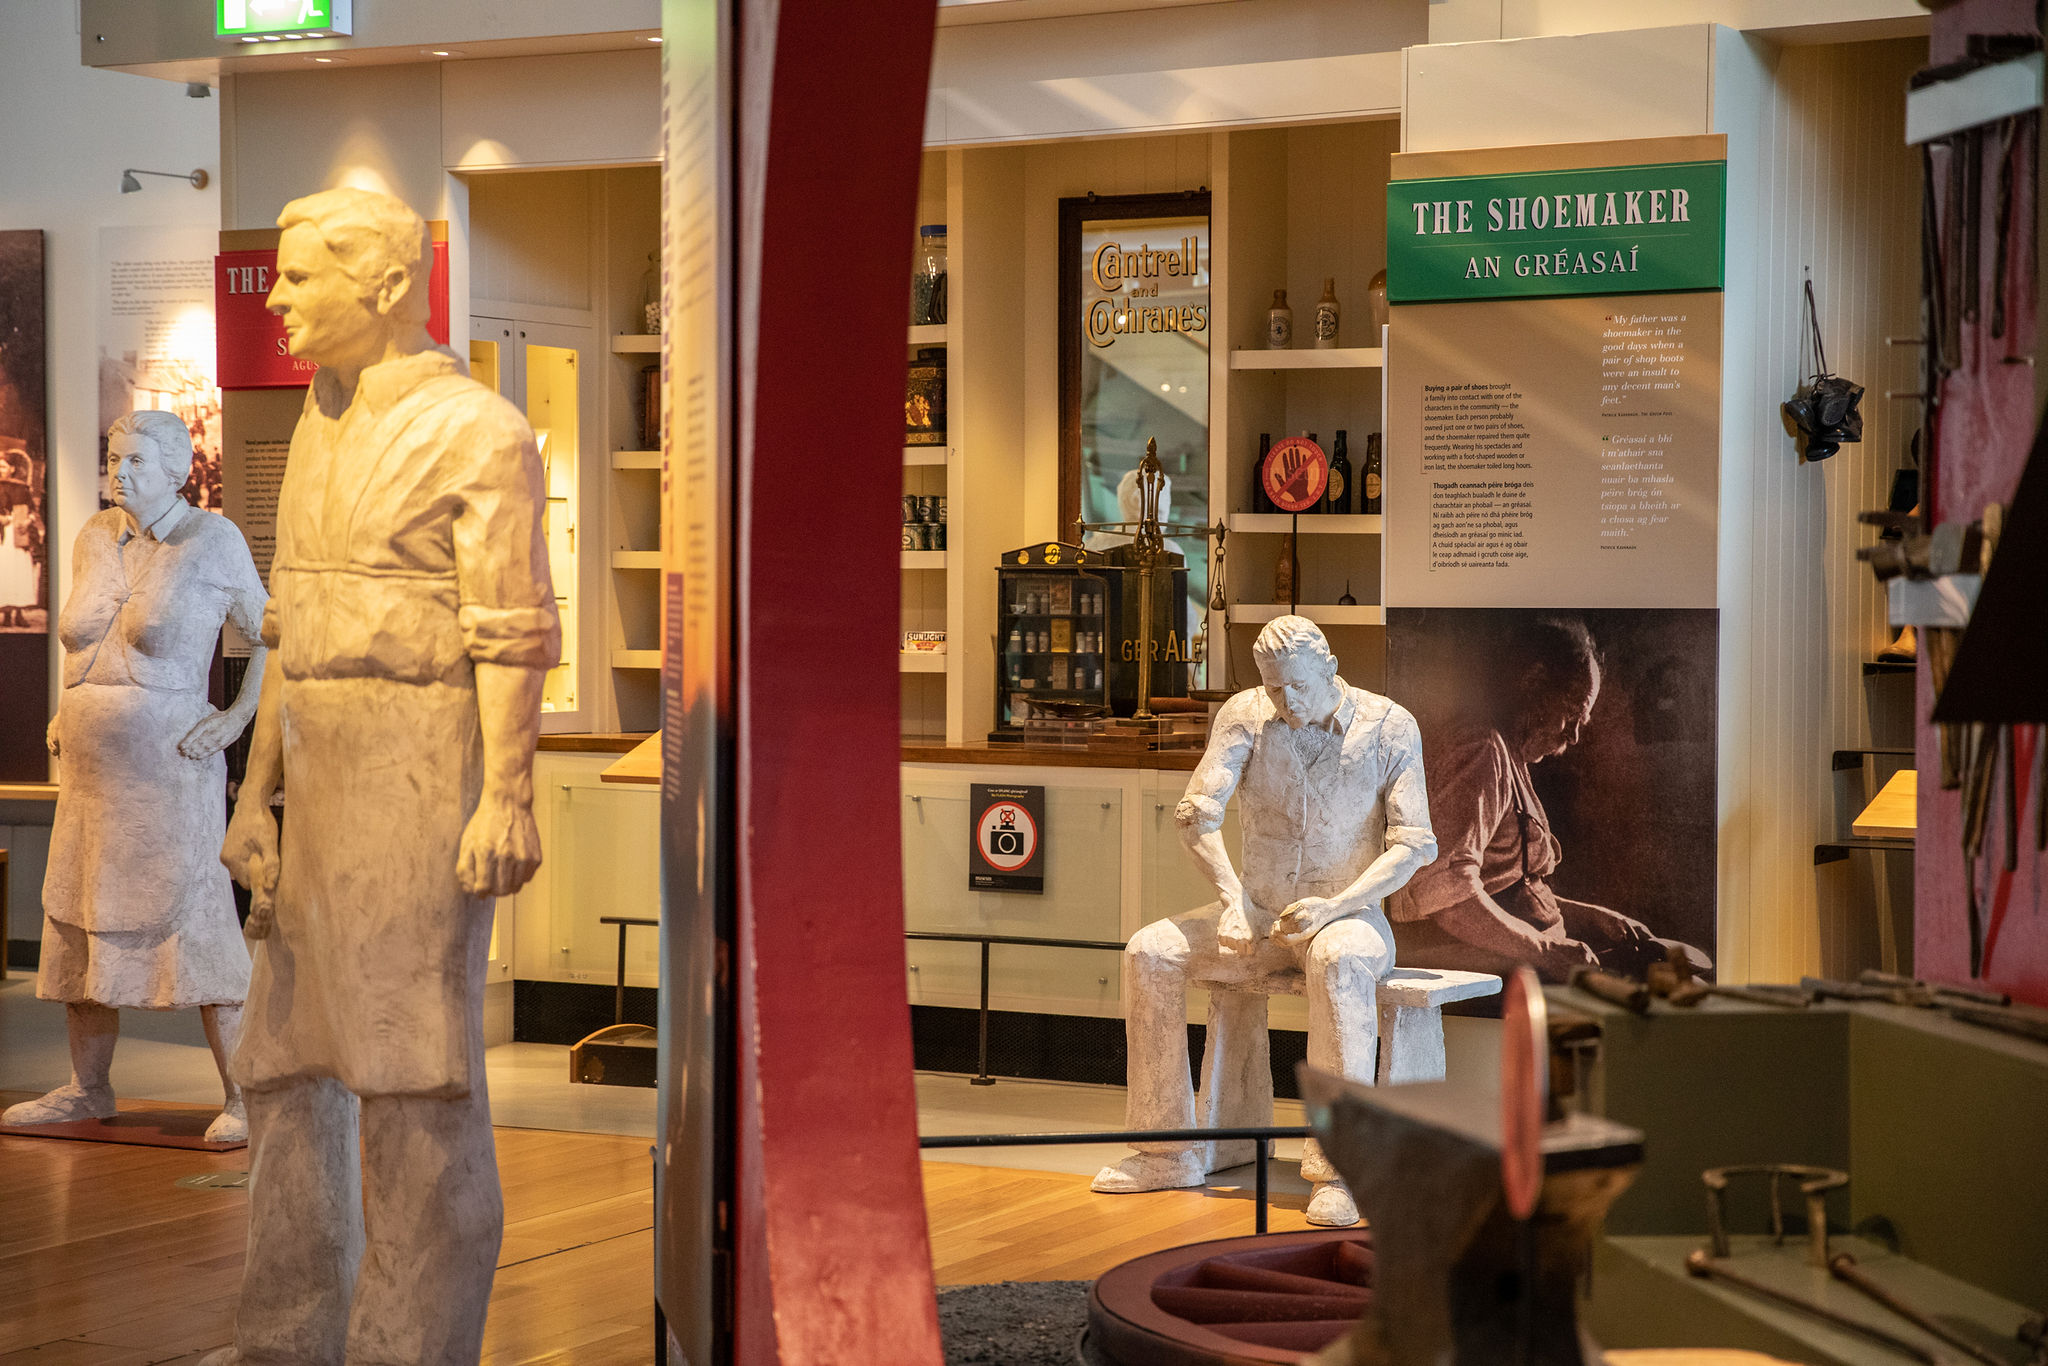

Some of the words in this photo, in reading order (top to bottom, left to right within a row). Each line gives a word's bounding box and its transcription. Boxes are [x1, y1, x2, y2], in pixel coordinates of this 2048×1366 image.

[1412, 199, 1473, 235] THE
[1487, 188, 1691, 232] SHOEMAKER
[1092, 236, 1199, 292] Cantrell
[1465, 256, 1501, 279] AN
[1514, 245, 1640, 278] GRÉASAÍ
[226, 266, 269, 294] THE
[1131, 283, 1159, 297] and
[1629, 314, 1657, 326] father
[1603, 328, 1652, 337] shoemaker
[1655, 327, 1664, 336] in
[1667, 326, 1681, 335] the
[1602, 342, 1624, 353] good
[1627, 342, 1647, 352] days
[1650, 340, 1674, 349] when
[292, 360, 320, 371] AGUS
[1602, 356, 1621, 366] pair
[1624, 355, 1634, 366] of
[1635, 354, 1656, 365] shop
[1660, 354, 1684, 363] boots
[1642, 368, 1667, 377] insult
[1670, 368, 1680, 376] to
[1602, 383, 1618, 393] any
[1621, 382, 1651, 391] decent
[1654, 380, 1680, 389] man's
[1433, 482, 1458, 490] Thugadh
[1441, 522, 1454, 530] gach
[908, 633, 944, 641] SUNLIGHT
